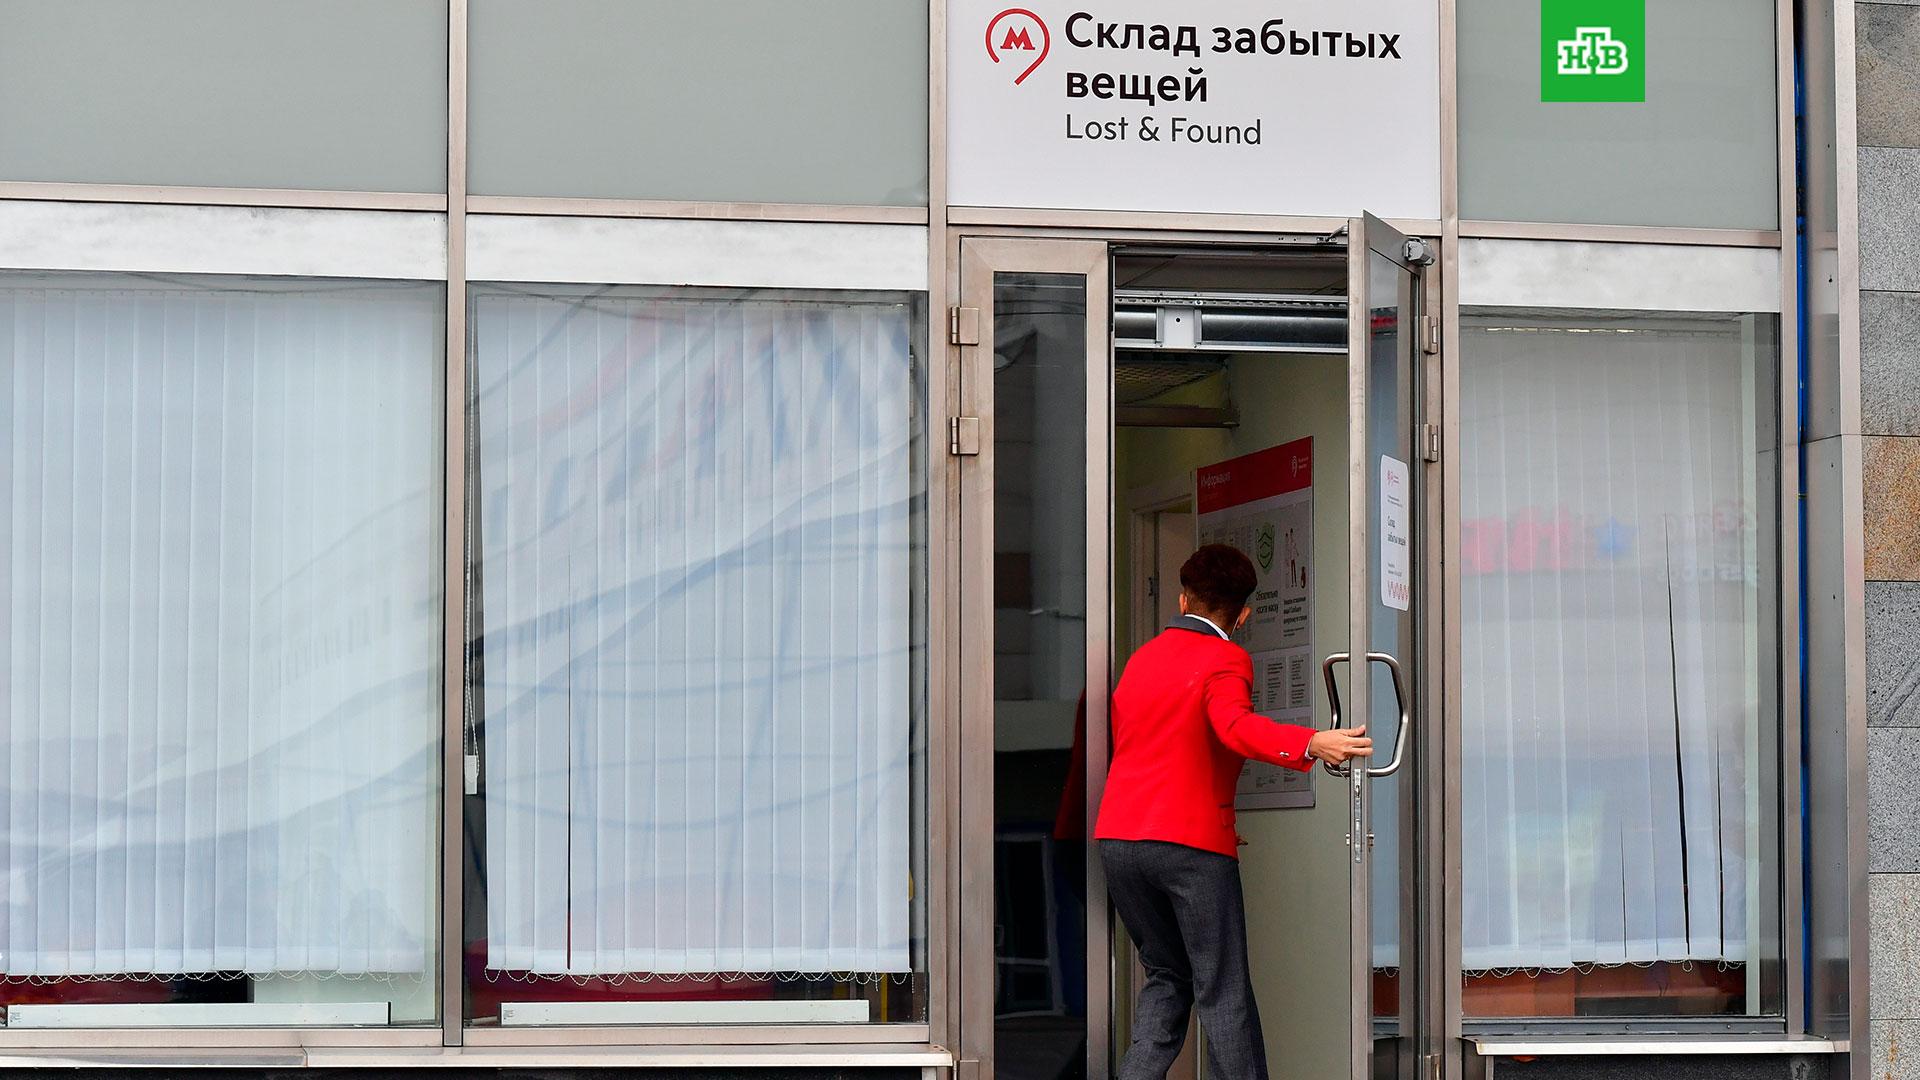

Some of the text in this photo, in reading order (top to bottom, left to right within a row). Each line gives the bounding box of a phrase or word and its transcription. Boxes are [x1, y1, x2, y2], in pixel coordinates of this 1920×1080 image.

[1066, 12, 1402, 59] Склад забытых
[1066, 67, 1207, 106] вещей
[1066, 114, 1261, 145] Lost & Found
